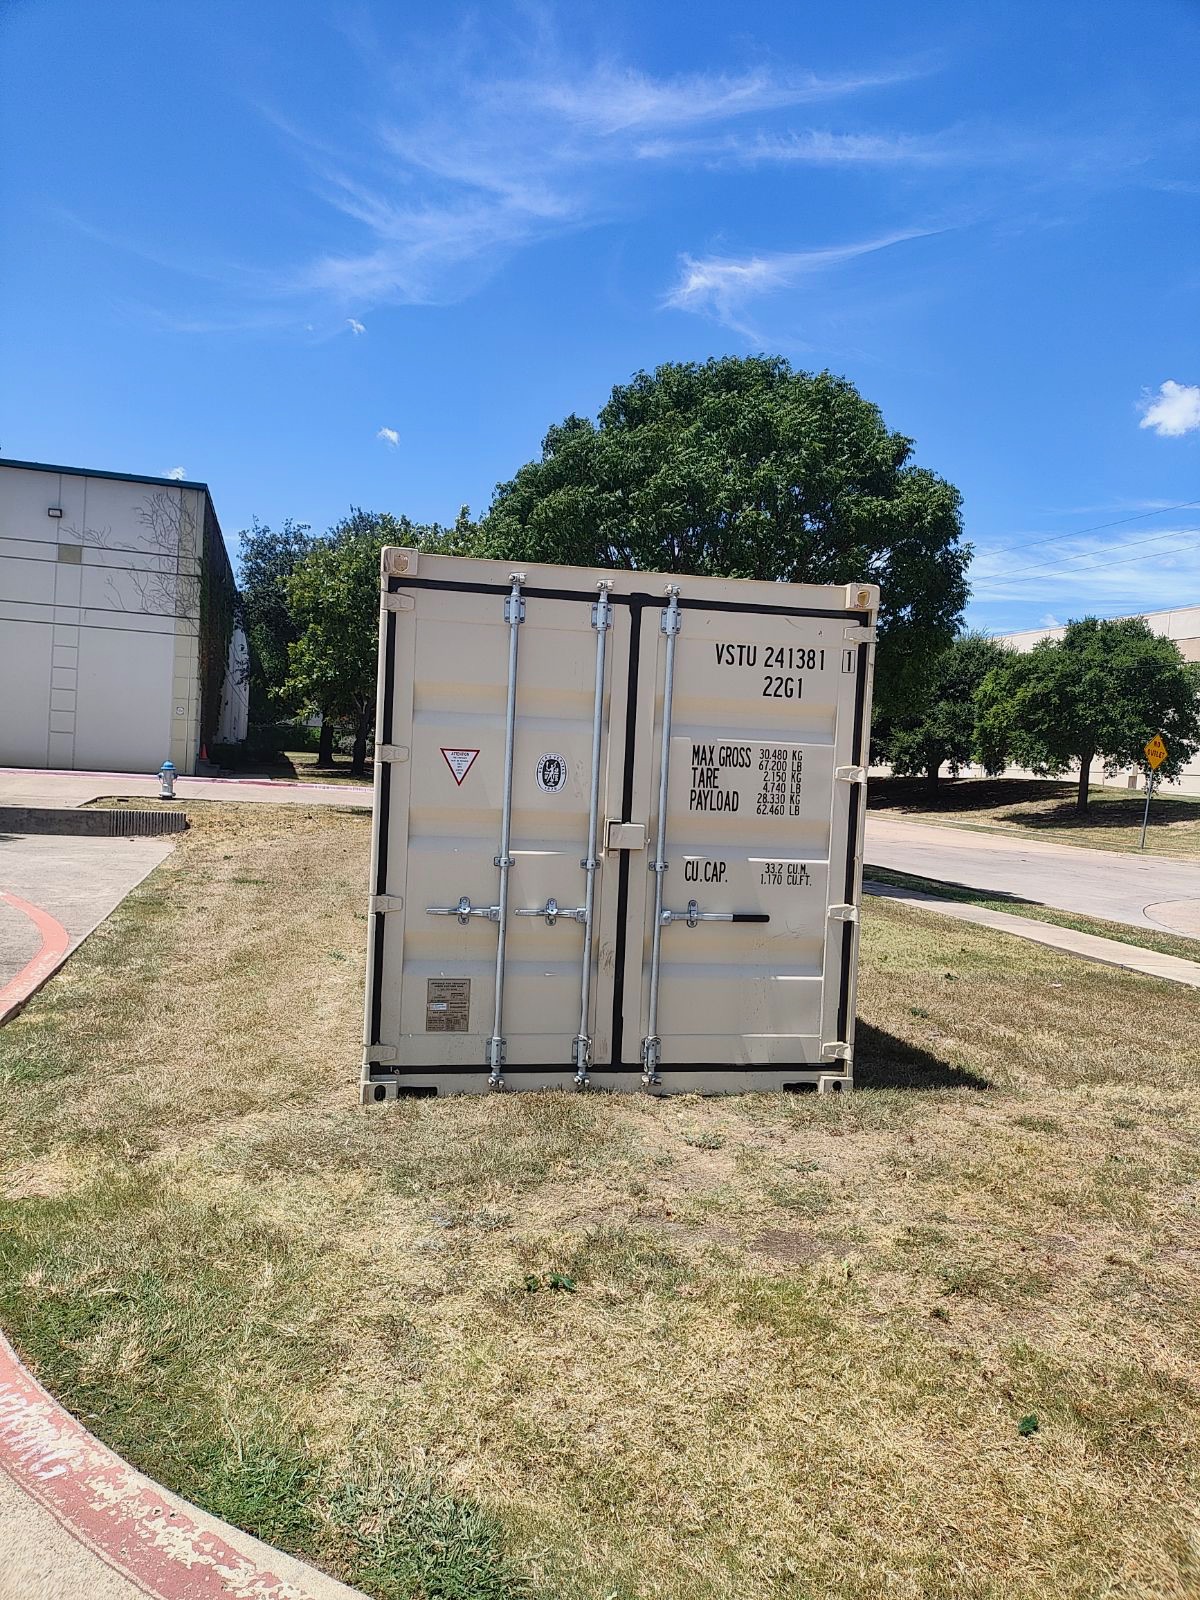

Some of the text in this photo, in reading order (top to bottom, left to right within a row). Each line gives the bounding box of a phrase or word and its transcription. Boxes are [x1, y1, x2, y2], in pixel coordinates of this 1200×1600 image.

[715, 643, 757, 667] VSTU
[763, 646, 825, 671] 241381
[762, 675, 803, 699] 22G1
[691, 744, 752, 769] MAX GROSS
[759, 748, 803, 762] 30.480 KG
[758, 759, 803, 773] 67.200 LB
[691, 766, 720, 790] TARE
[763, 770, 802, 784] 2.150 KG
[762, 781, 802, 795] 4.740 LB
[689, 789, 740, 812] PAYLOAD
[756, 792, 801, 806] 28.330 KG
[756, 803, 801, 816] 62.460 LB
[764, 862, 784, 875] 33.2
[760, 873, 783, 886] 1.170
